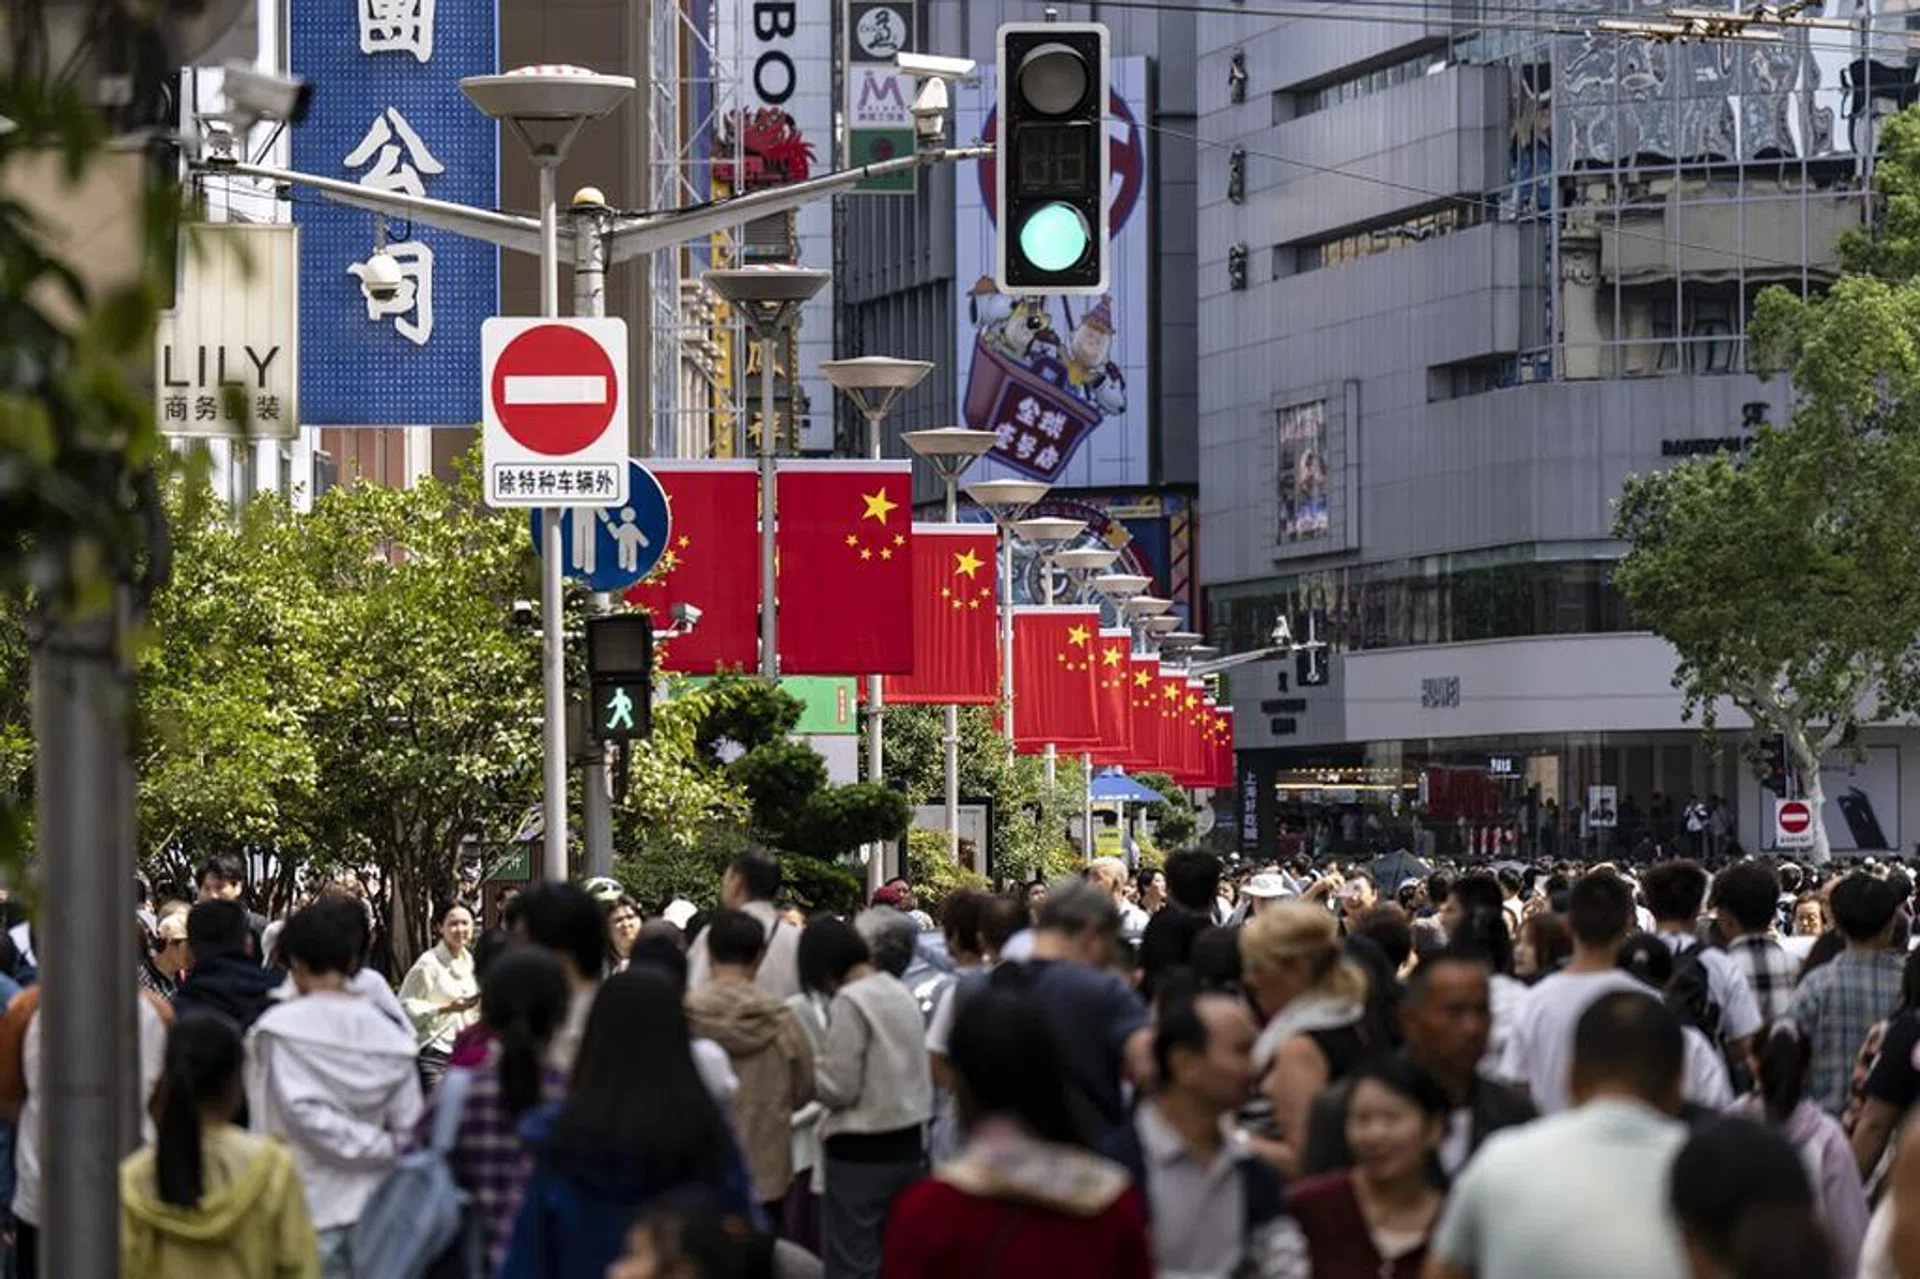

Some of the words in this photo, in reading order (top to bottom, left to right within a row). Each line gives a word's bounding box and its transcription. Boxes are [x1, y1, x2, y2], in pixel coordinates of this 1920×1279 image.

[753, 2, 796, 105] BO
[164, 345, 279, 387] LILY
[165, 395, 279, 421] 商务装
[499, 469, 614, 494] 除特种车辆外
